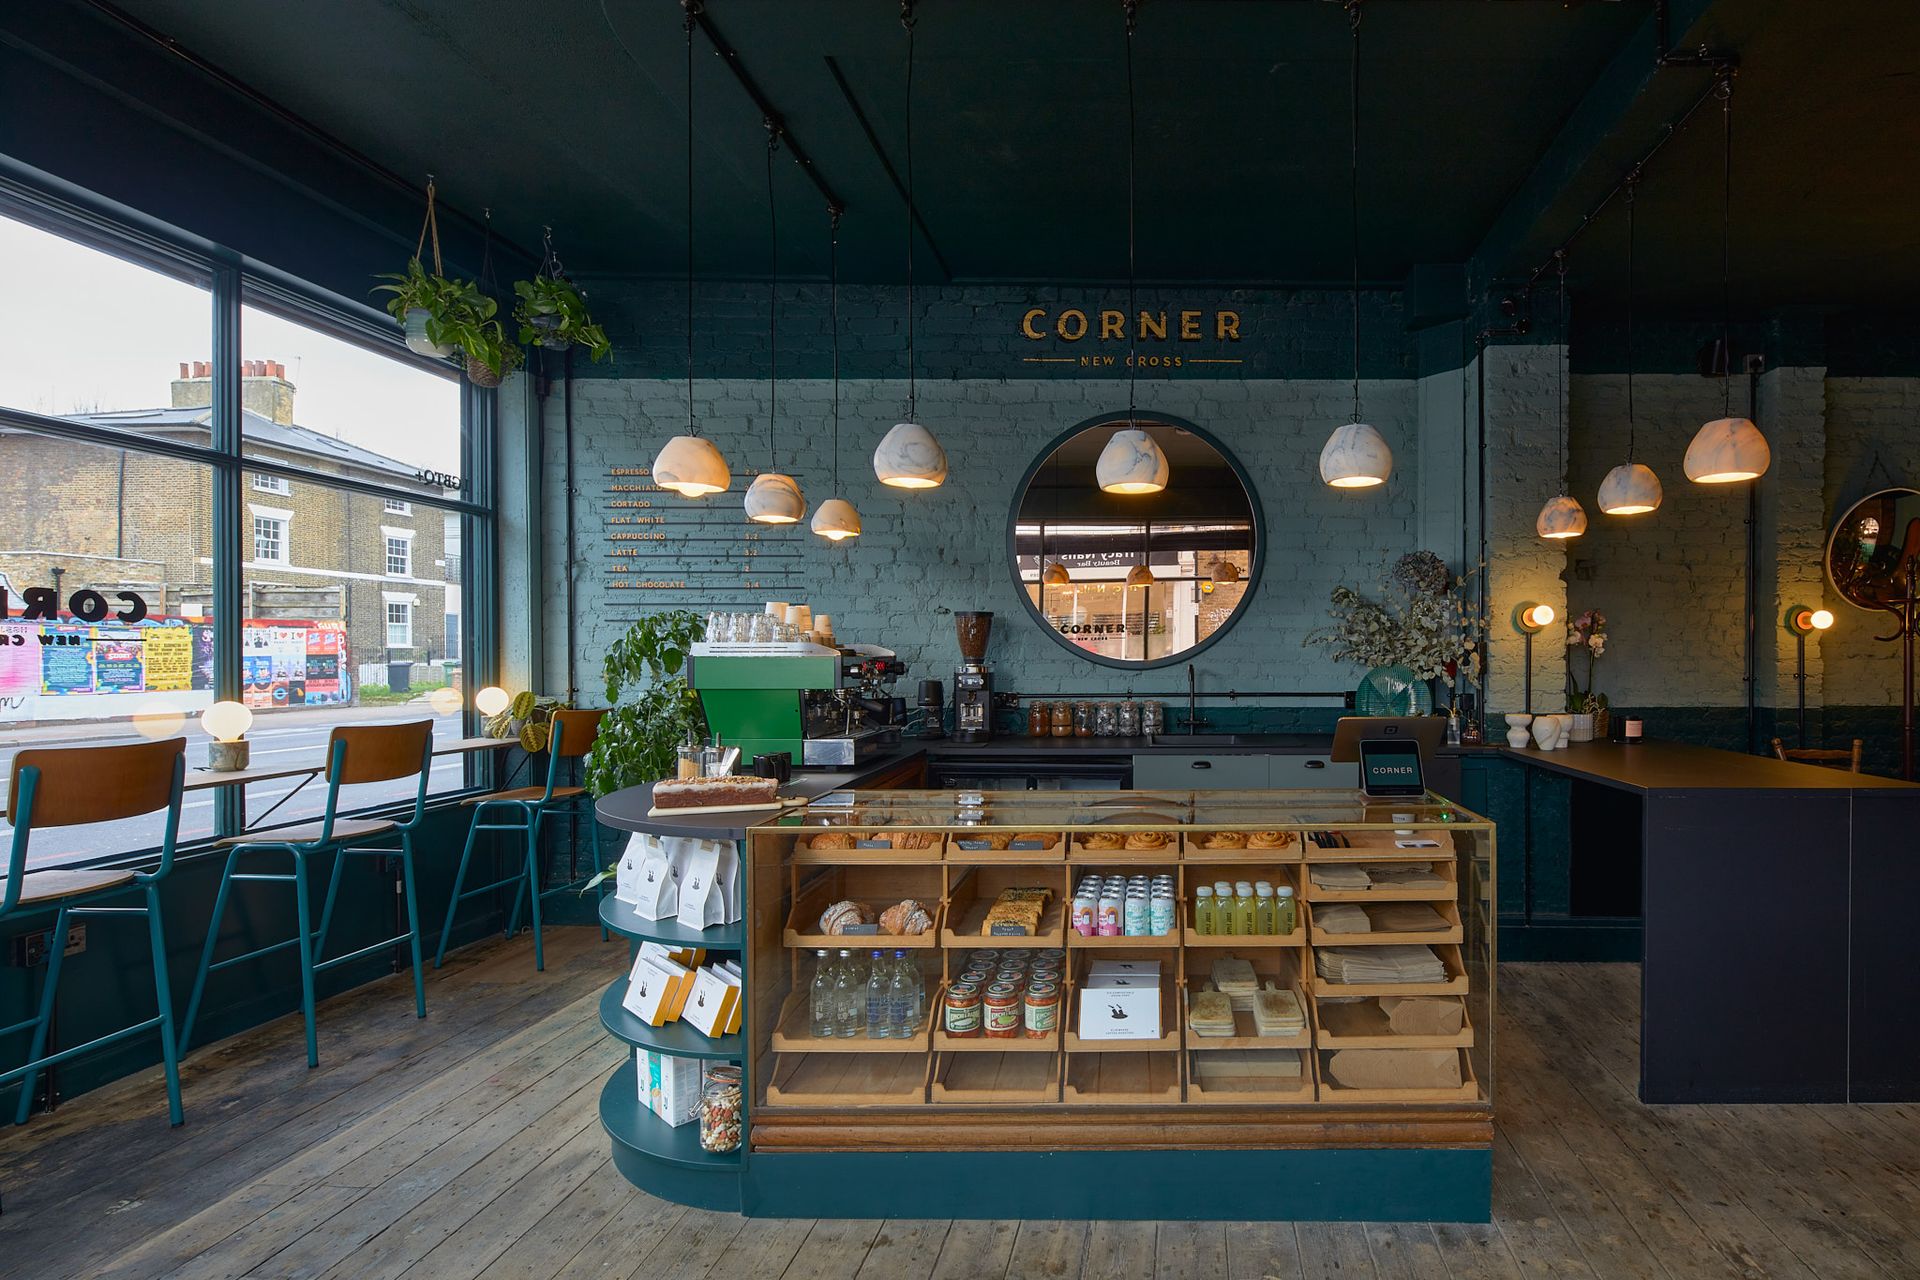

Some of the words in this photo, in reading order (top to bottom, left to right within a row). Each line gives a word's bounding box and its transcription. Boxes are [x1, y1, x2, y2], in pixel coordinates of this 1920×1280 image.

[1022, 308, 1241, 341] CORNER
[1080, 356, 1115, 367] NEW
[1126, 356, 1182, 367] CROSS
[611, 468, 649, 476] ESPRESSO
[1060, 624, 1125, 634] CORNER
